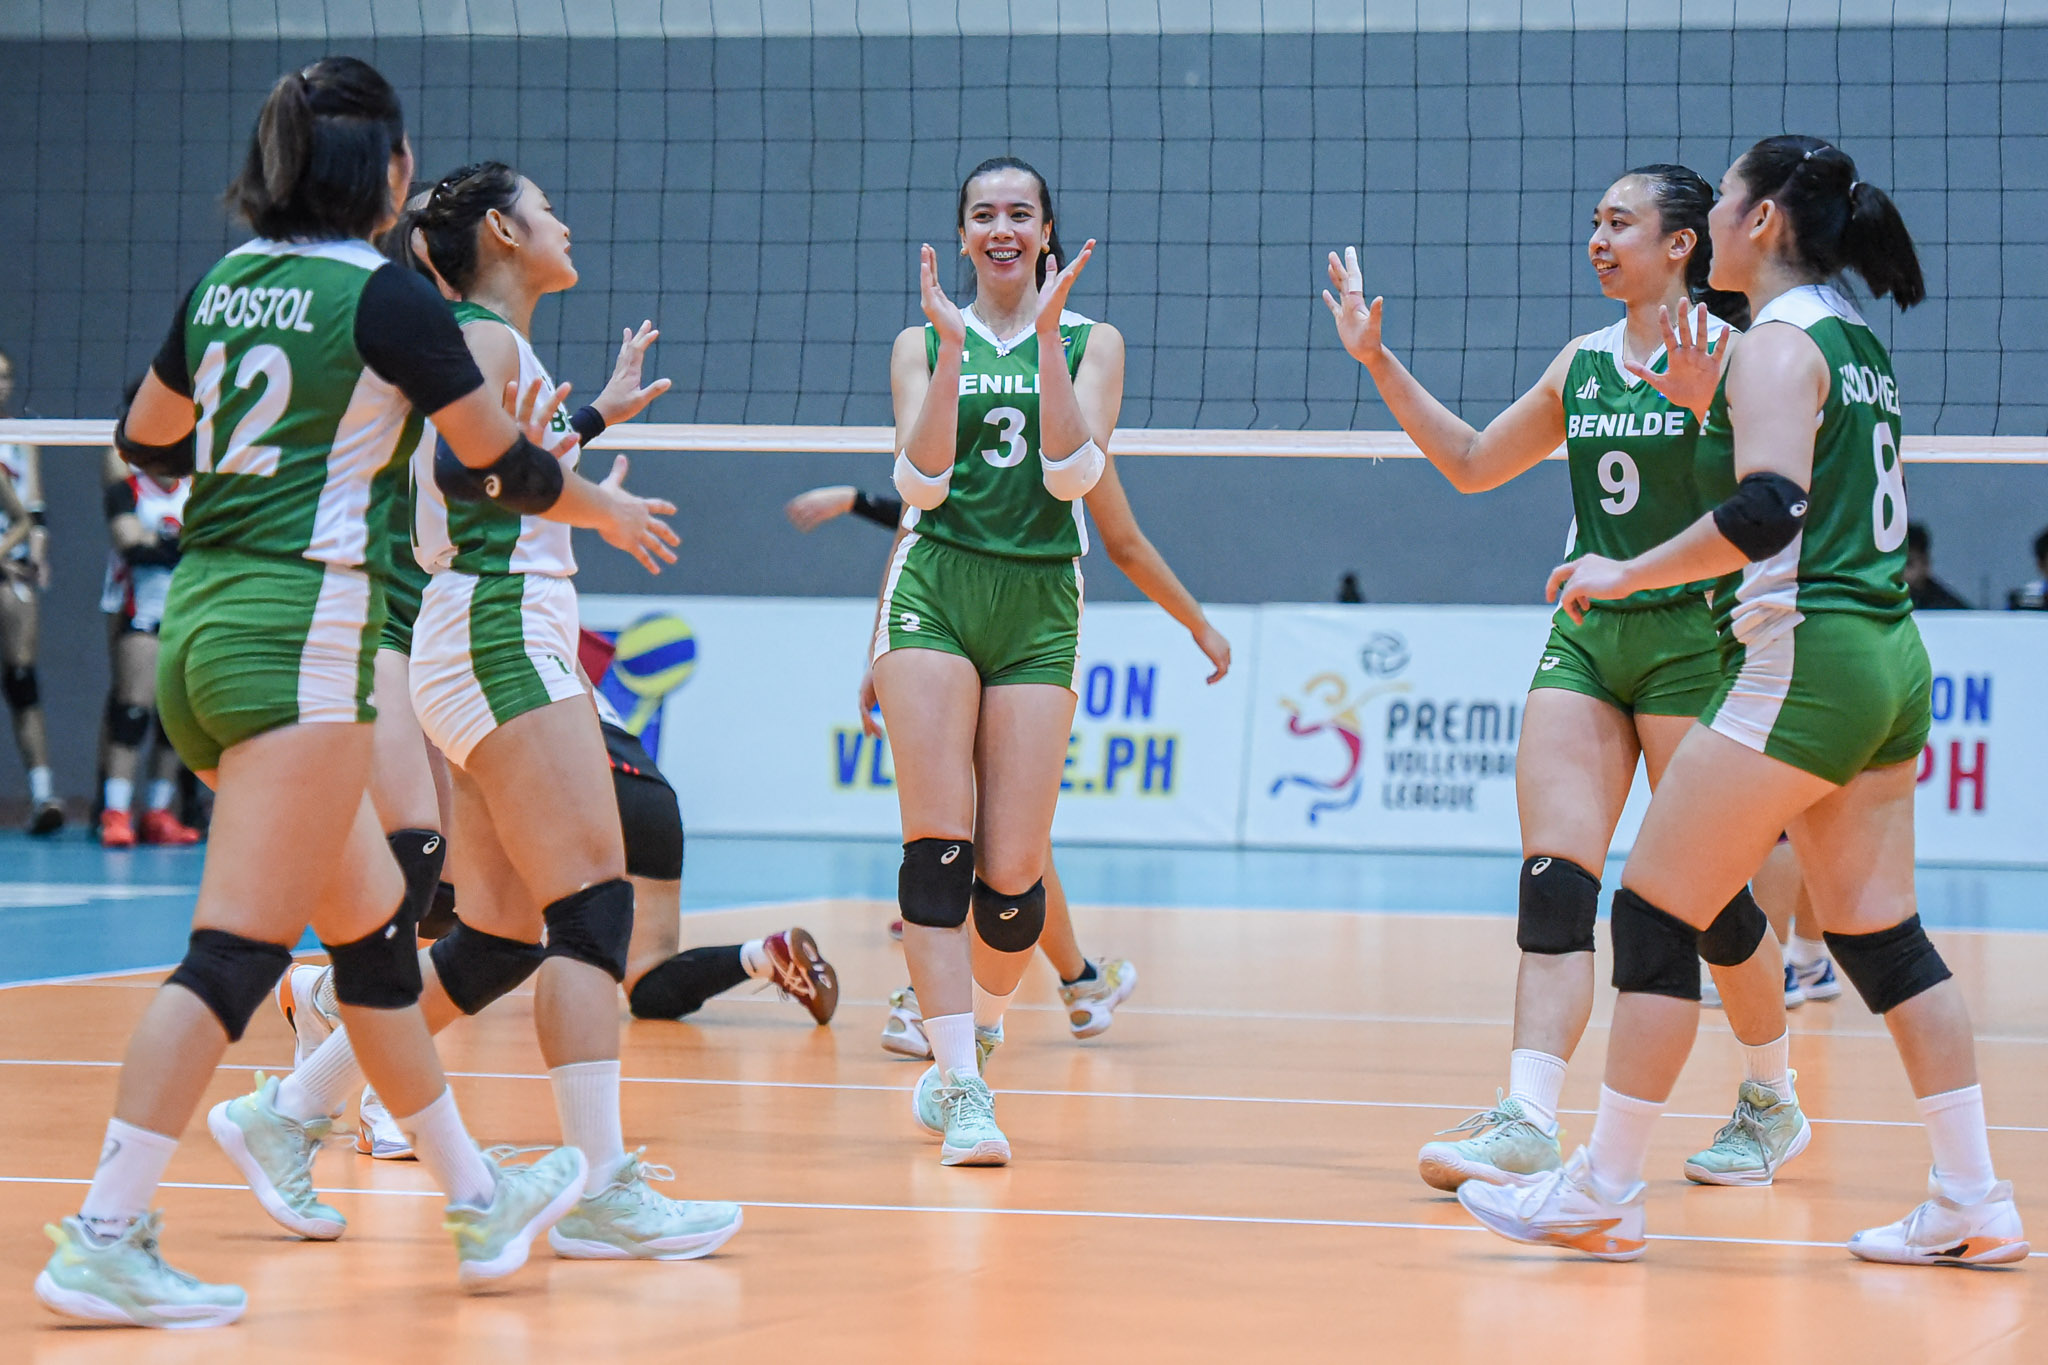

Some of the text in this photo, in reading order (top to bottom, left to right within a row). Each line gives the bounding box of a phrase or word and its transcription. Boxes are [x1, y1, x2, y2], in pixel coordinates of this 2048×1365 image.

[193, 284, 314, 332] APOSTOL
[958, 374, 1041, 395] ENIL
[193, 341, 293, 477] 12
[1568, 411, 1684, 438] BENILDE
[981, 406, 1028, 468] 3
[1597, 450, 1640, 515] 9
[1873, 422, 1907, 552] 8
[1086, 664, 1155, 719] ON
[1931, 675, 1992, 722] ON
[1386, 702, 1516, 743] PREMI
[1384, 752, 1516, 779] VOLLEYBA
[1382, 783, 1477, 812] LEAGUE
